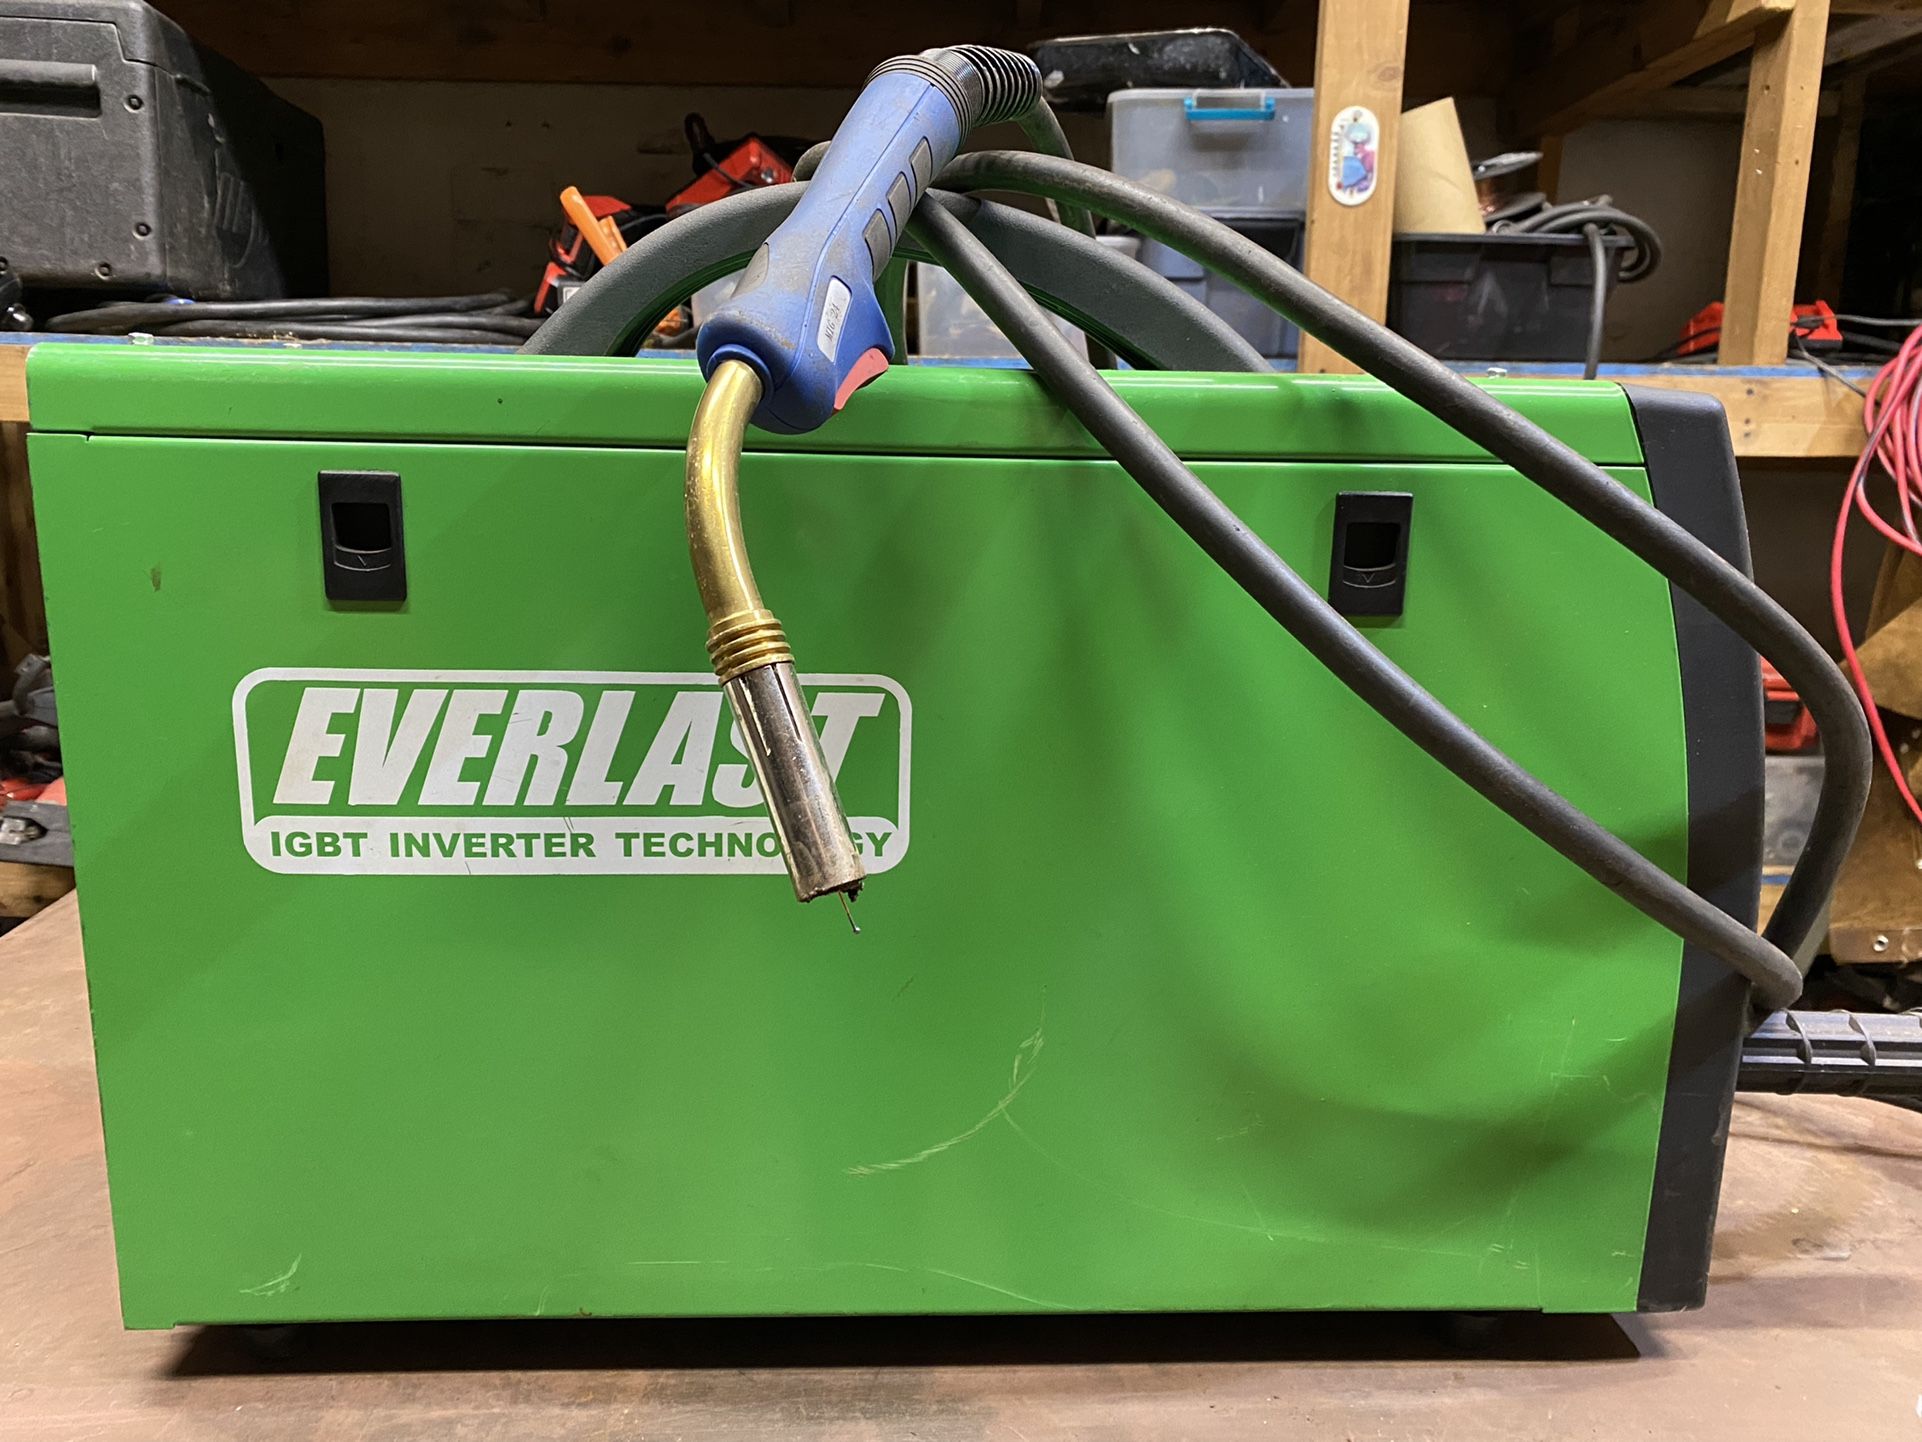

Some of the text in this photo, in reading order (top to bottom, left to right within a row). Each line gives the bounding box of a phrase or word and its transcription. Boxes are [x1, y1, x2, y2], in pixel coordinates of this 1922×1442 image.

[825, 320, 836, 342] MIG
[270, 831, 892, 858] IGBT INVERTER TECHNOY
